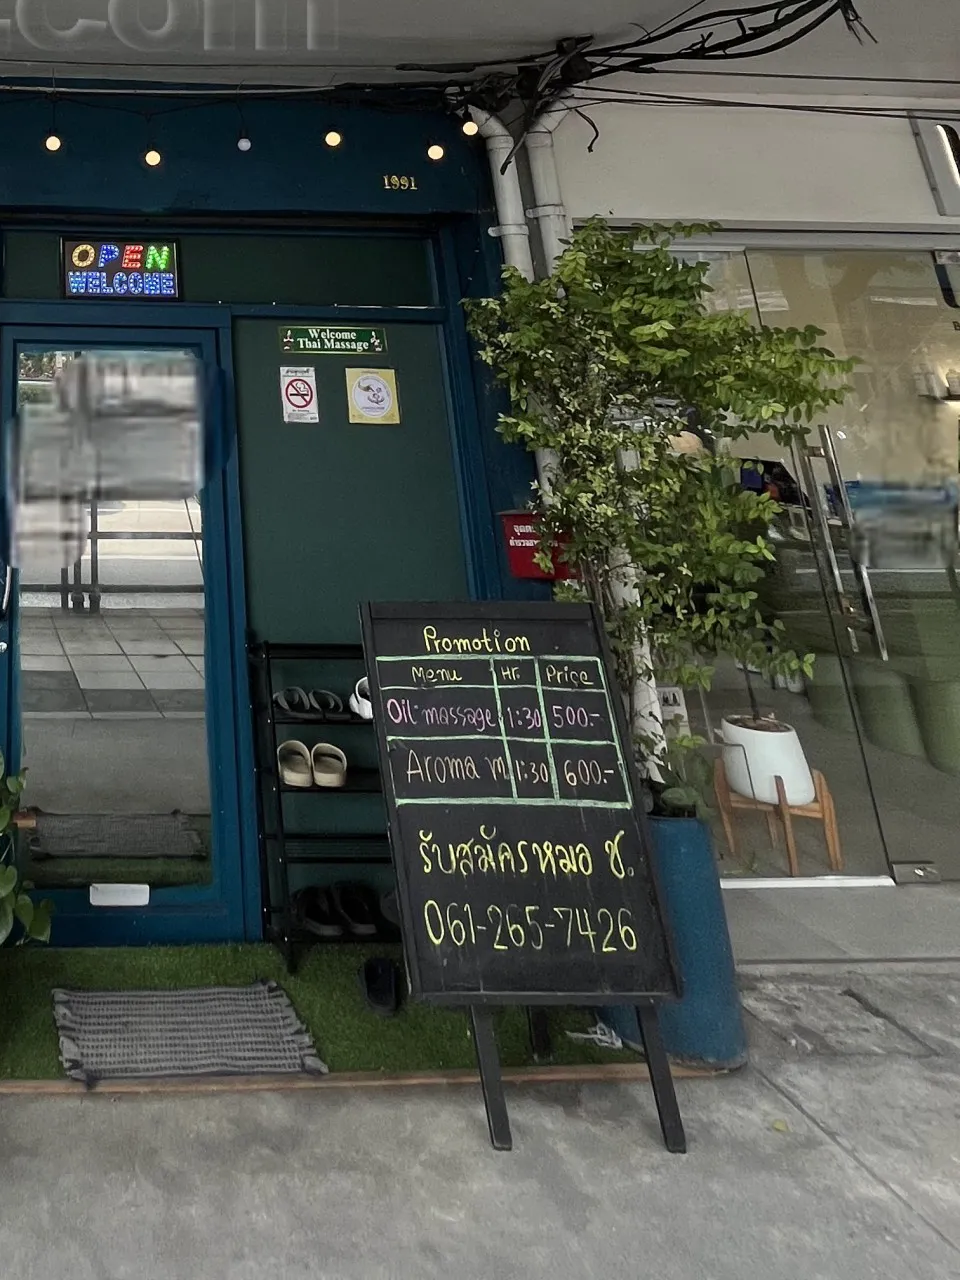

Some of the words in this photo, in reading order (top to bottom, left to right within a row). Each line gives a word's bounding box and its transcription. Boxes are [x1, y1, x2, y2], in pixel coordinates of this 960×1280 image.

[382, 175, 418, 190] 1991
[71, 244, 170, 269] OPEN
[68, 271, 175, 295] WELCOME
[297, 338, 320, 349] Thai
[324, 339, 369, 352] Massage
[308, 329, 357, 340] Welcome
[423, 625, 531, 653] Promotion
[411, 666, 463, 683] Menu
[546, 666, 594, 687] Price
[422, 706, 497, 732] massage
[506, 706, 542, 730] 1:30
[406, 749, 480, 783] Aroma
[515, 760, 549, 784] 1:30
[424, 900, 638, 953] 061-265-7426
